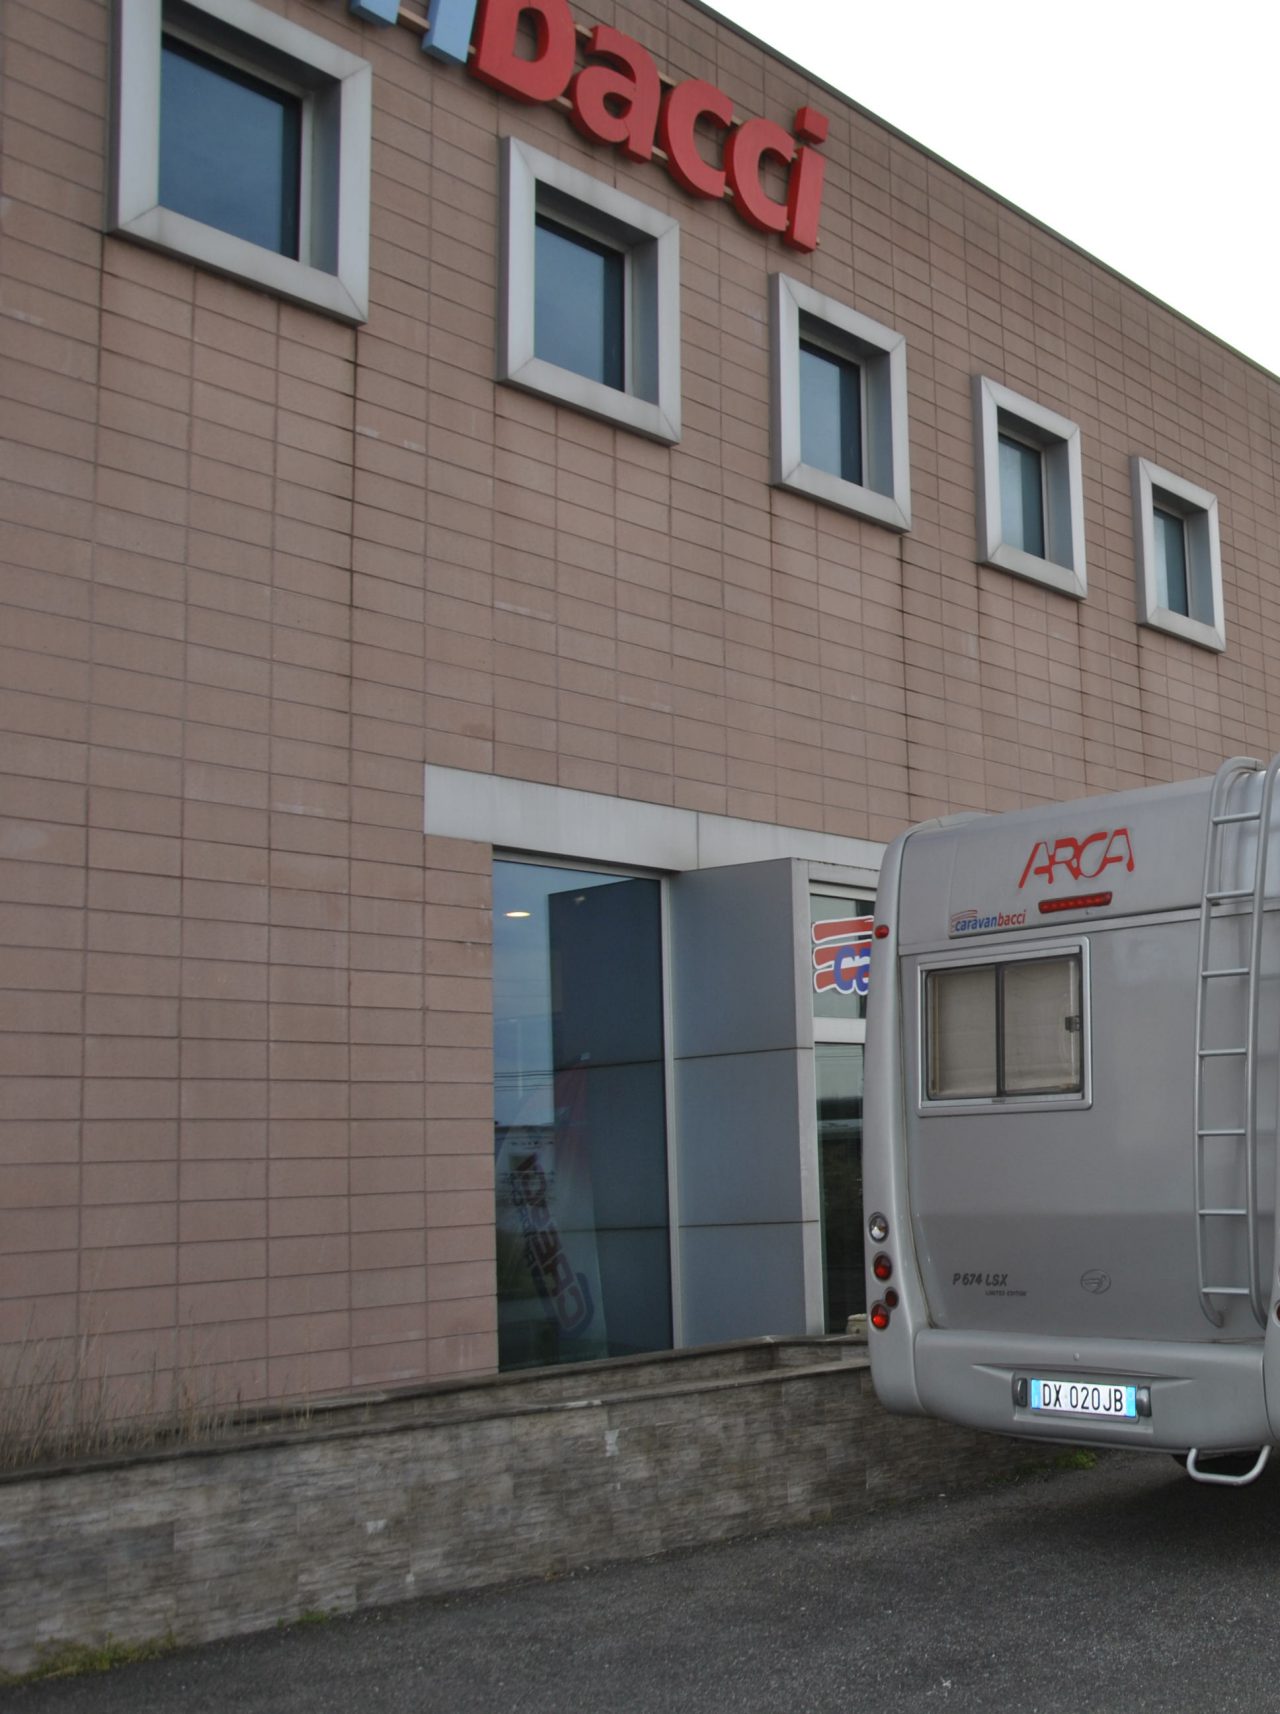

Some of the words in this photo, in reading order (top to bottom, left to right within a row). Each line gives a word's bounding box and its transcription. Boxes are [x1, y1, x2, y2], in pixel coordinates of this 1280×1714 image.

[1017, 828, 1135, 889] ARCA
[954, 909, 1027, 932] caravanbacci
[952, 1272, 961, 1286] P
[962, 1272, 983, 1287] 674
[985, 1273, 1009, 1287] LSX
[1042, 1383, 1062, 1408] DX
